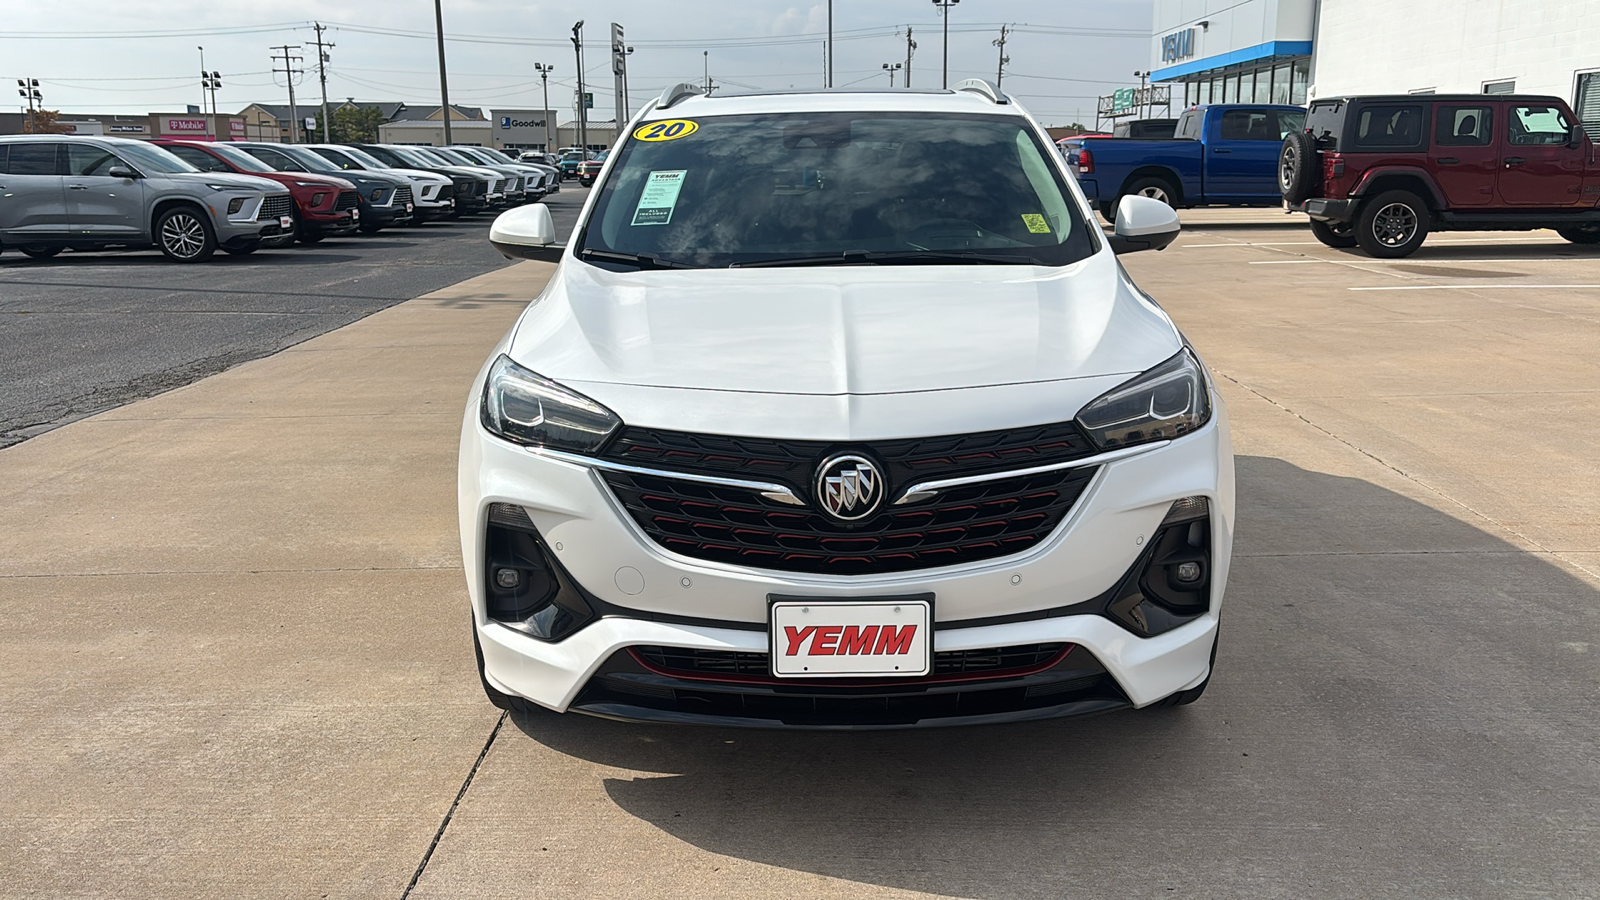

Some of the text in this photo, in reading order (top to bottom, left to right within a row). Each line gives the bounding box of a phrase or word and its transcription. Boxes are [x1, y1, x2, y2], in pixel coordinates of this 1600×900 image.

[1161, 28, 1195, 61] YEMM
[511, 119, 546, 128] Goodwill
[644, 122, 686, 139] 20
[784, 625, 917, 656] YEMM
